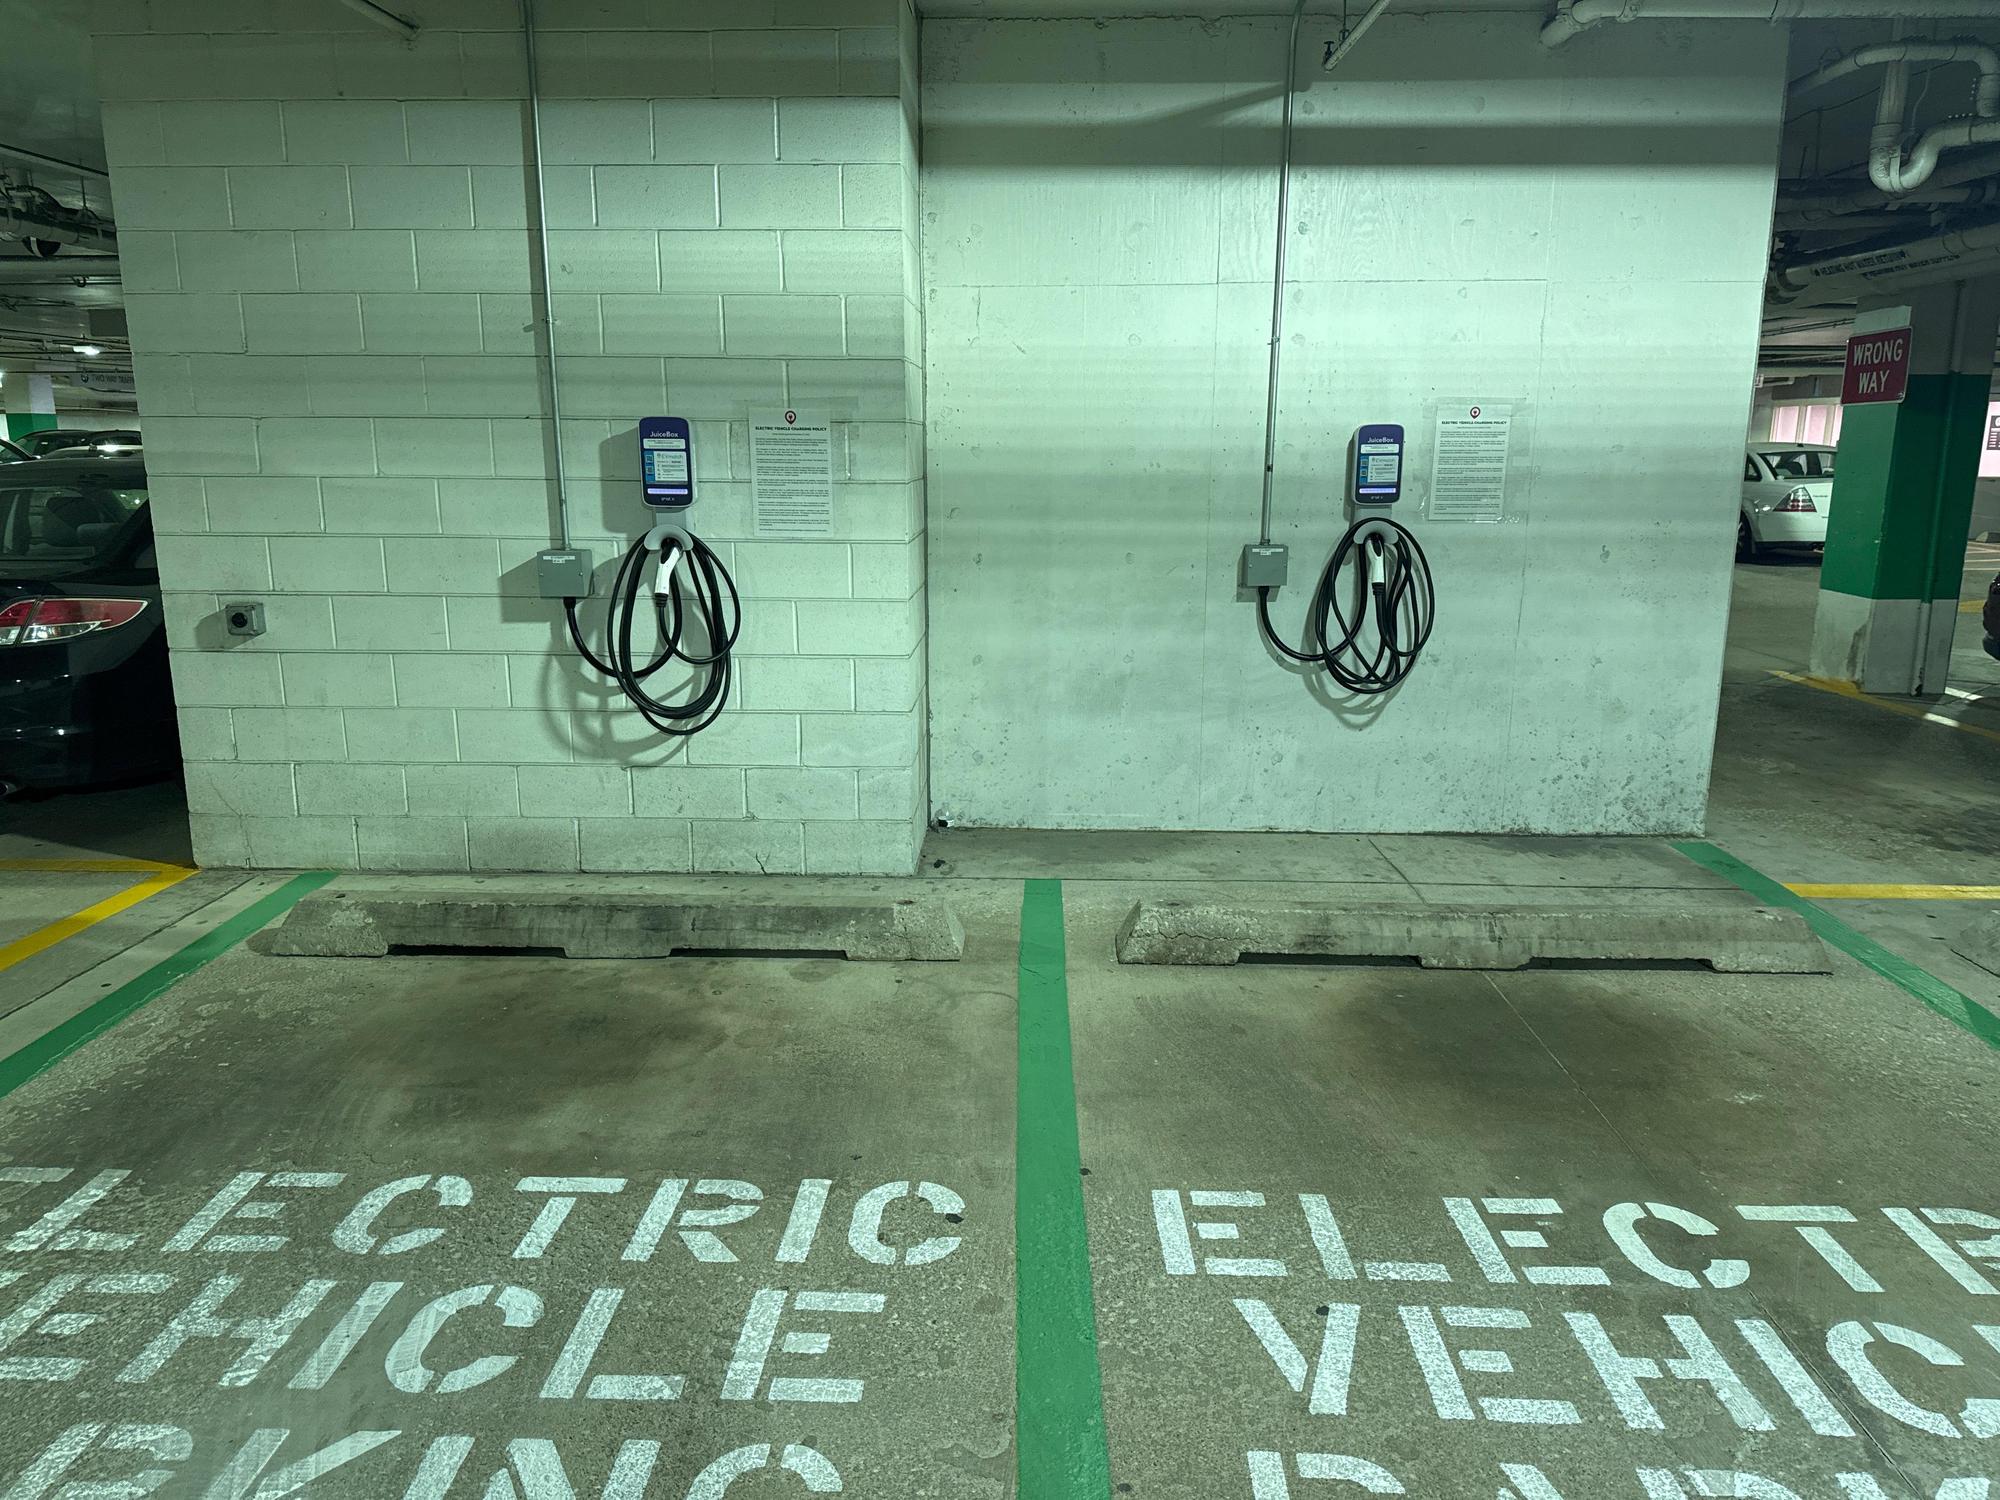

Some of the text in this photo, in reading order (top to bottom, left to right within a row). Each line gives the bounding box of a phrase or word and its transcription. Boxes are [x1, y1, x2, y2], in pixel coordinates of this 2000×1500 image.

[1853, 338, 1903, 366] WRONG
[1858, 369, 1890, 394] WAY
[0, 1271, 888, 1404] EHICLE
[1232, 1298, 2000, 1440] VEHIC
